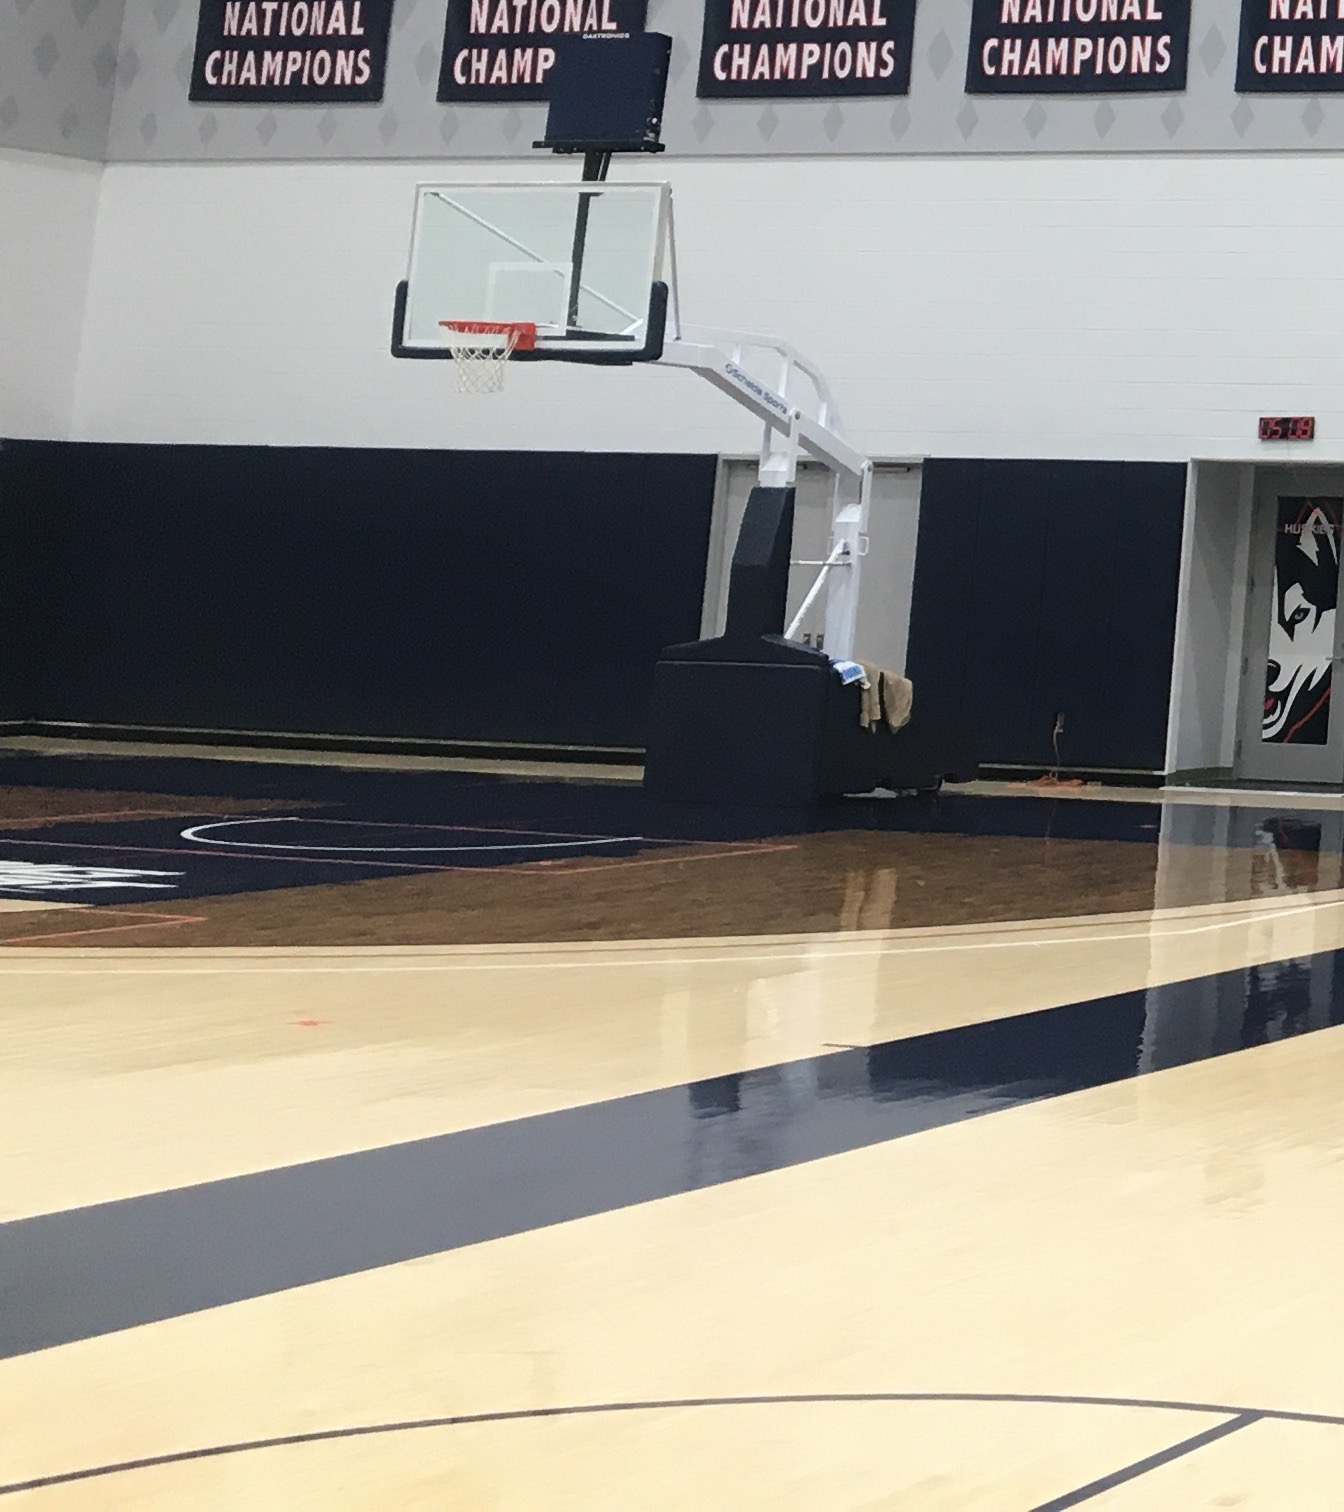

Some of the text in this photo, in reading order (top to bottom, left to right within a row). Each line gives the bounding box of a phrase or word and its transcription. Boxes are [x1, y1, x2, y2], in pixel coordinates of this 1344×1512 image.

[223, 0, 365, 37] NATIONAL
[204, 48, 371, 86] CHAMPIONS
[453, 47, 556, 85] CHAMP
[713, 40, 895, 81] CHAMPIONS
[982, 34, 1171, 76] CHAMPIONS
[763, 391, 788, 415] Sports
